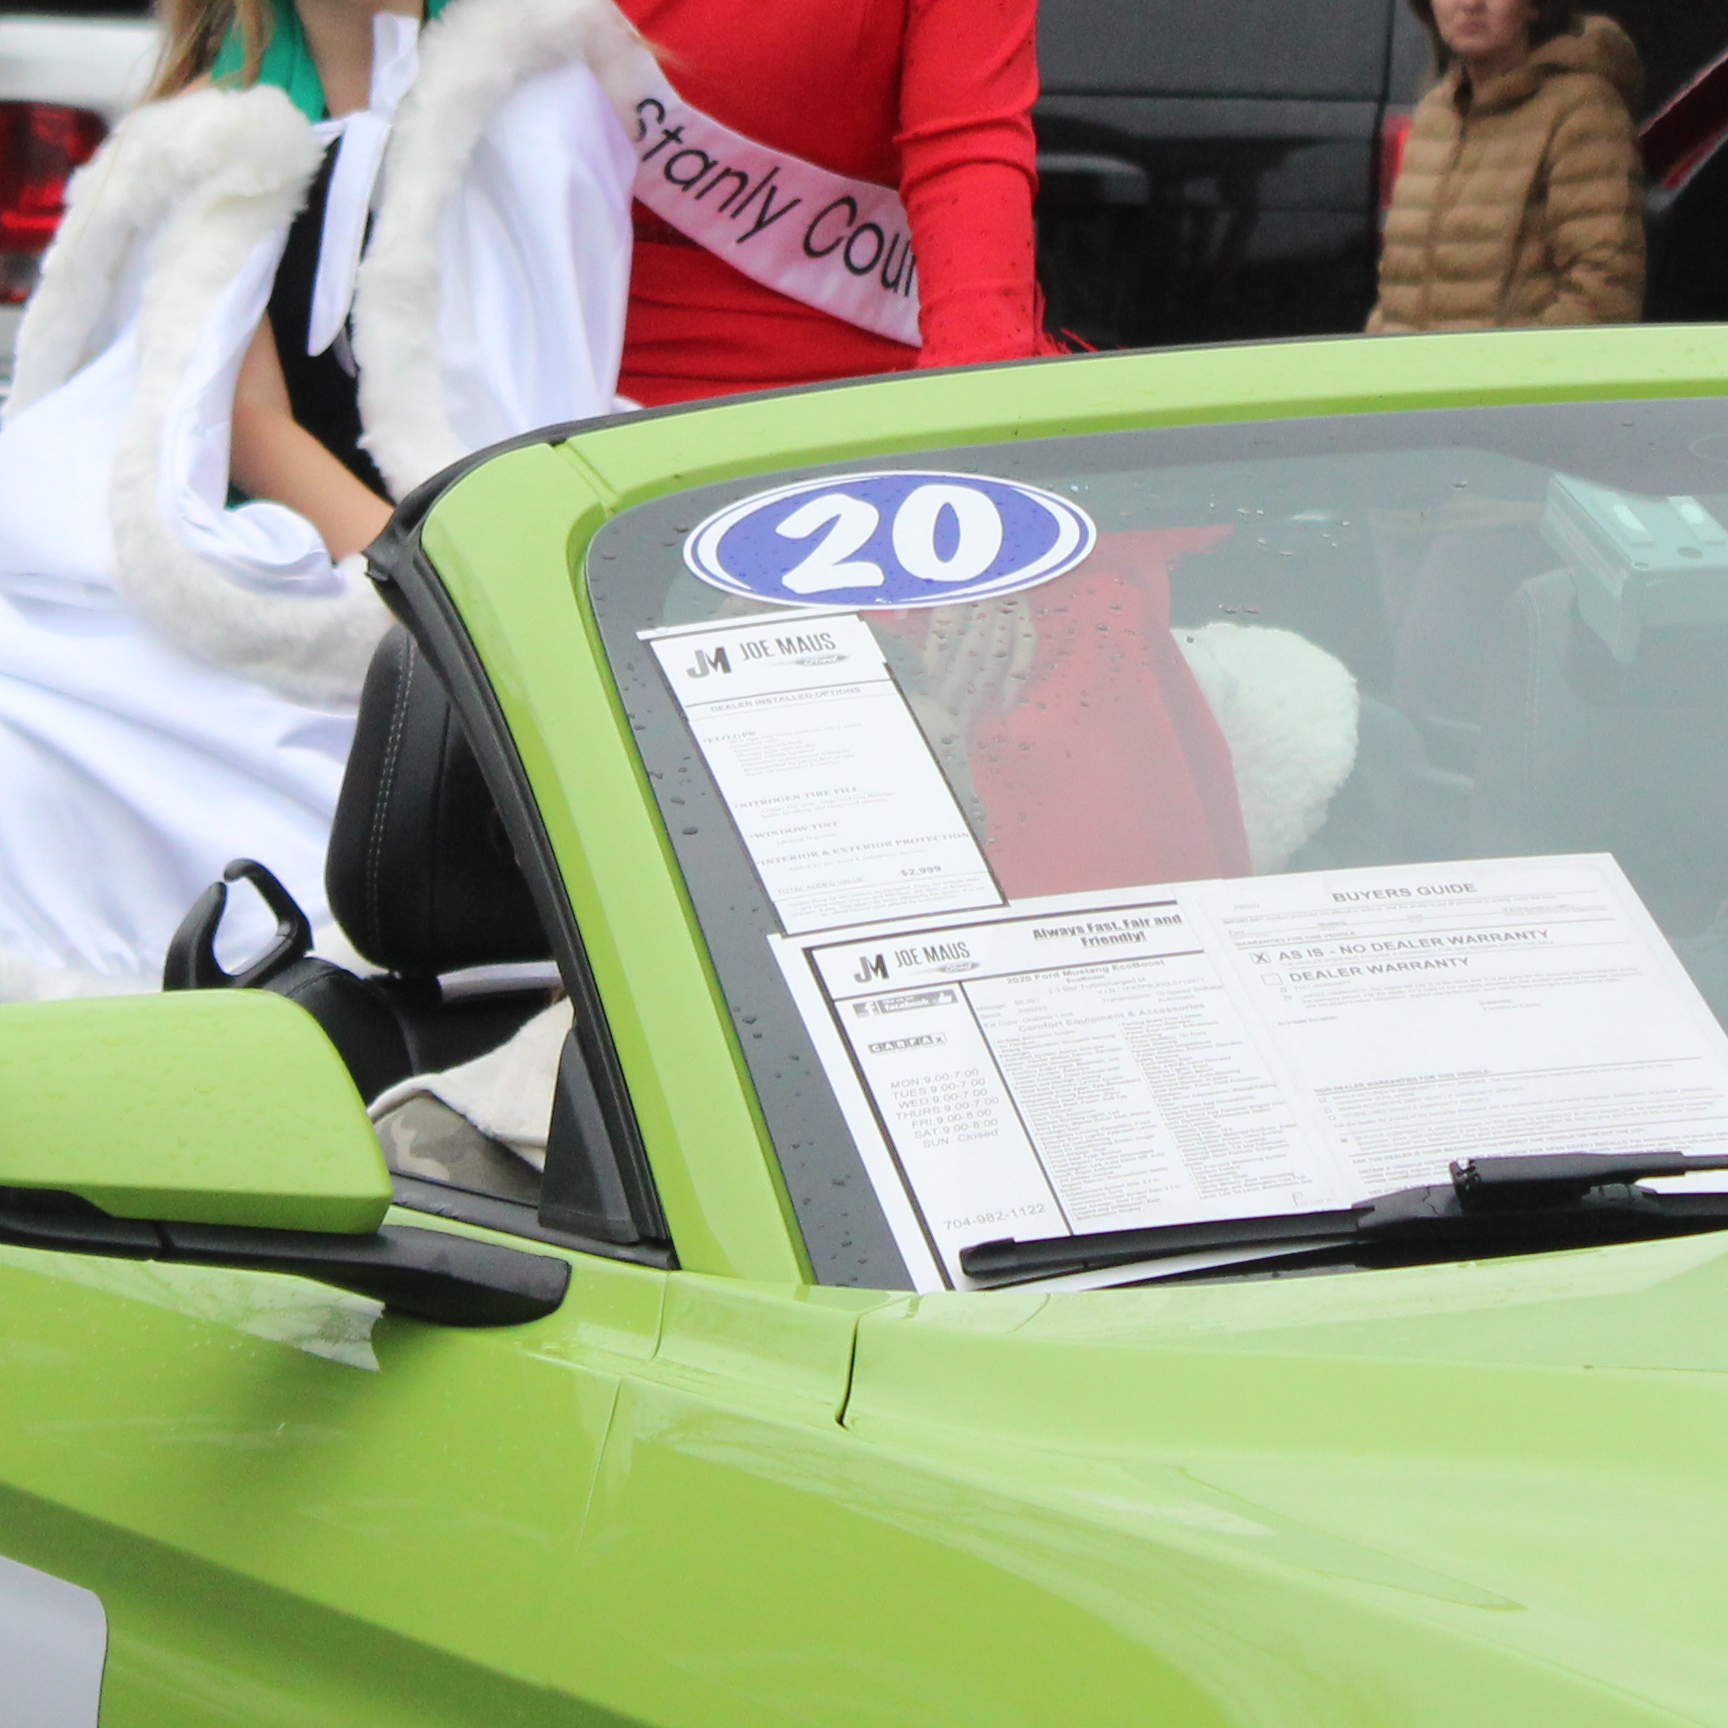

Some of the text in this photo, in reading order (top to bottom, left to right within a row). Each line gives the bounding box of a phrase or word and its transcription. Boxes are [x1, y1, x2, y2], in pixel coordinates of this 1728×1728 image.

[635, 98, 803, 244] Stanly
[774, 483, 1004, 595] 20
[739, 632, 837, 662] JOE MAUS
[710, 686, 862, 713] DEALER INSTALLED OPTIONS
[1332, 882, 1478, 904] BUYERS GUIDE
[1032, 924, 1086, 941] Always
[1121, 916, 1152, 931] Fair
[1153, 913, 1183, 927] and
[1080, 930, 1148, 949] Friendly!
[894, 941, 972, 969] JOE MAUS
[1278, 949, 1303, 962] AS
[1305, 947, 1325, 959] IS
[1338, 943, 1367, 956] NO
[1370, 936, 1443, 954] DEALER
[1443, 928, 1551, 947] WARRANTY
[1034, 970, 1060, 982] Ford
[1061, 965, 1110, 978] Mustang
[1110, 958, 1167, 972] EcoBoost
[1288, 957, 1471, 984] DEALER WARRANTY
[1017, 1020, 1064, 1034] Comfort
[1065, 1011, 1125, 1027] Equipment
[1138, 1002, 1207, 1017] Accessories
[956, 1129, 999, 1143] Closed
[943, 1202, 1047, 1231] 704-982-1122
